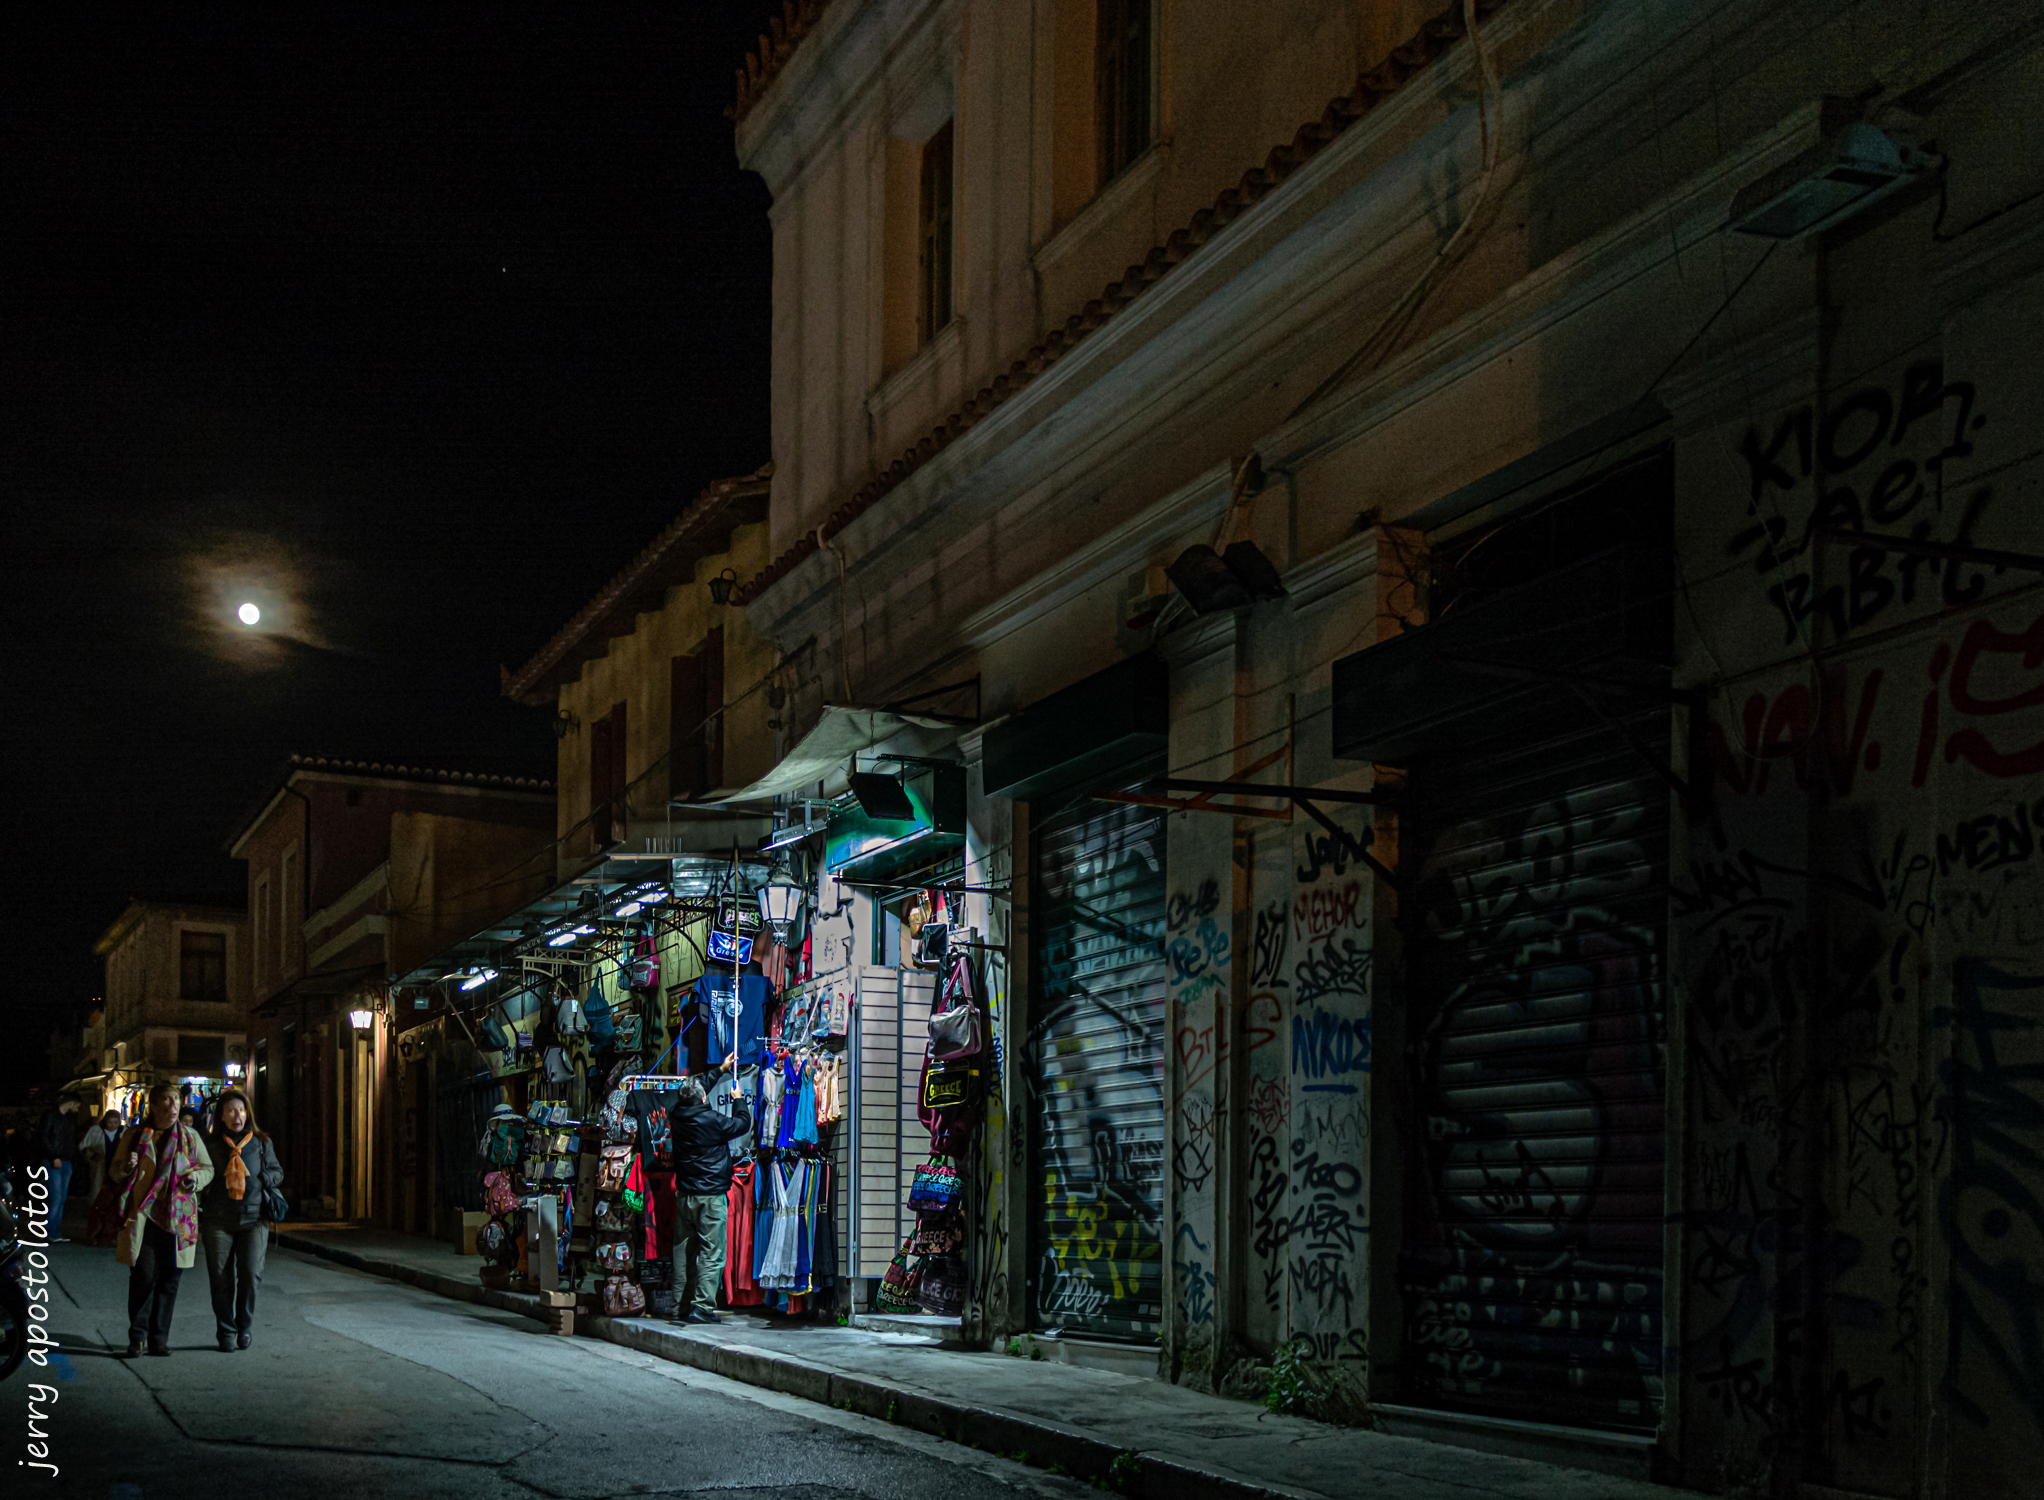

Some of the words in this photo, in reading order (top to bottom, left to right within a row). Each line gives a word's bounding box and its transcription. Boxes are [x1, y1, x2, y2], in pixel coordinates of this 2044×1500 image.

[716, 946, 744, 959] Greee
[930, 1080, 961, 1097] GREECE
[717, 1094, 757, 1106] GRECE
[916, 1229, 946, 1245] GREECE
